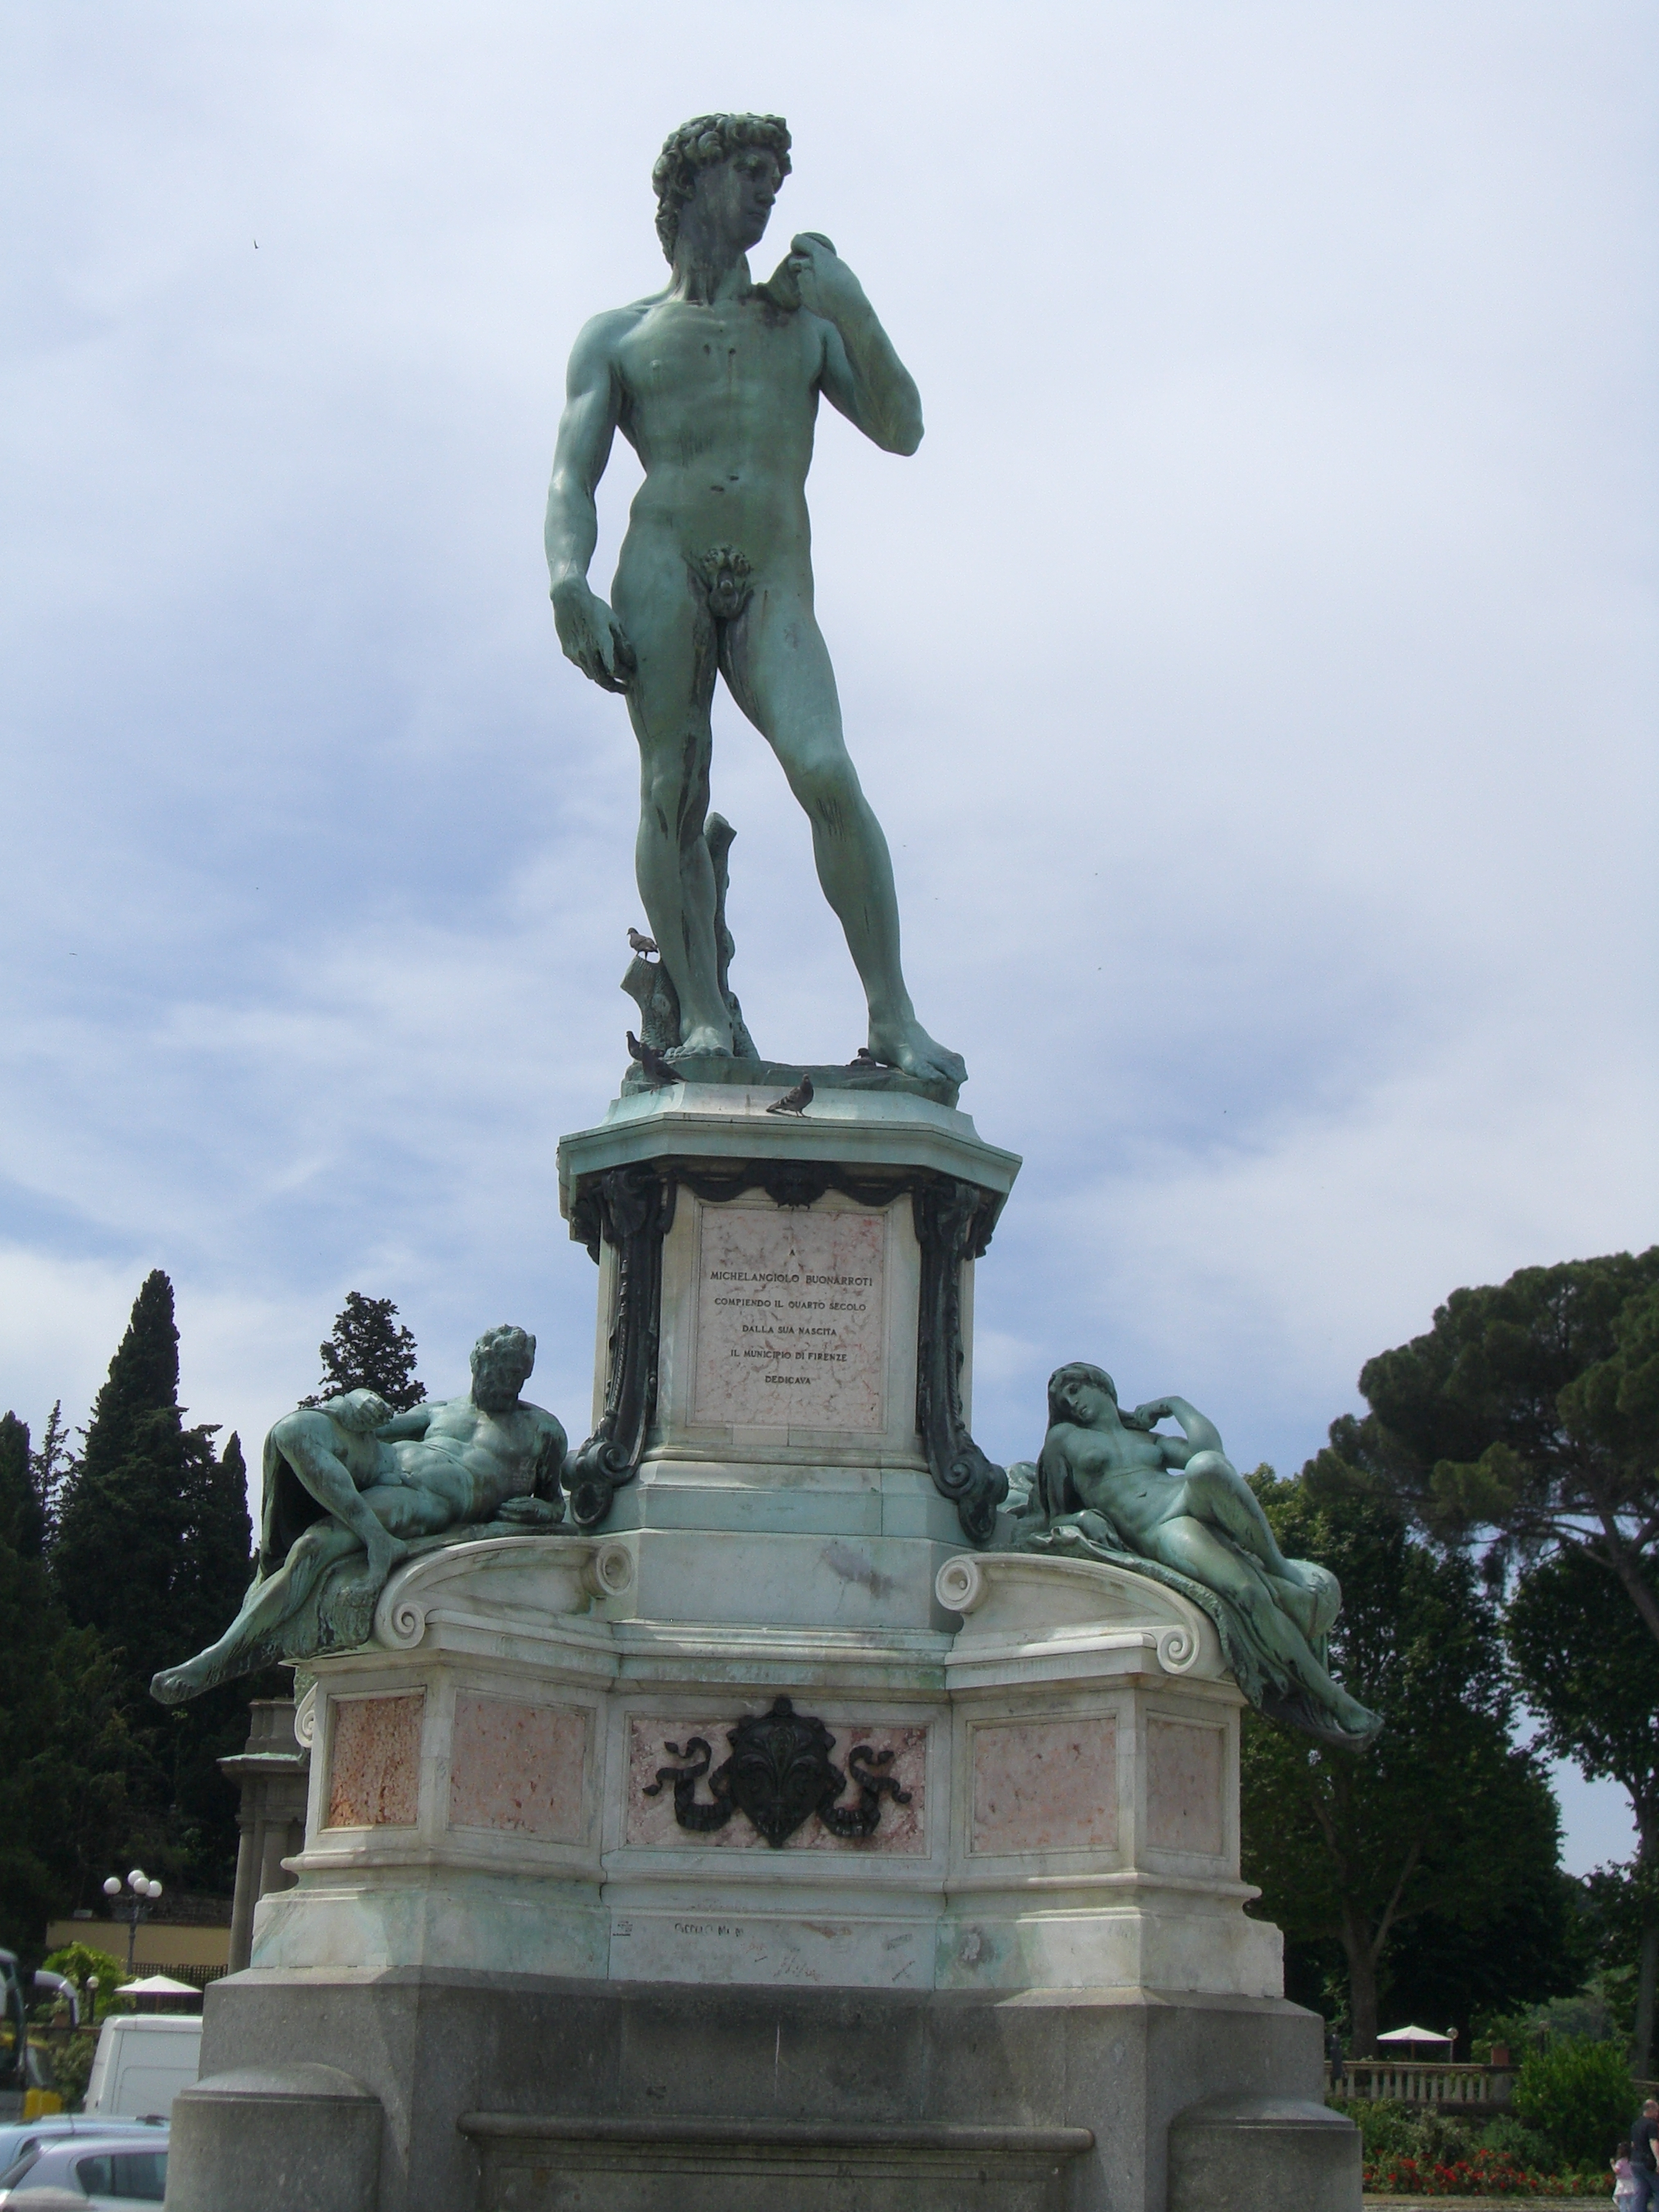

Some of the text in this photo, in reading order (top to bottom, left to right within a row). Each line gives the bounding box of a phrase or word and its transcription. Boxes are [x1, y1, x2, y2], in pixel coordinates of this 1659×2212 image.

[710, 1271, 873, 1286] MICHELANGIOLO BUONARROTI
[714, 1298, 771, 1308] COMPIENDO
[788, 1300, 825, 1310] QUARTO
[830, 1303, 866, 1311] SECOLO
[742, 1325, 774, 1334] DALLA
[799, 1327, 837, 1336] NASCITA
[731, 1349, 739, 1357] IL
[744, 1349, 791, 1359] MUNICIPIO
[808, 1353, 848, 1362] FIRENZE
[765, 1375, 811, 1385] DEDICAVA
